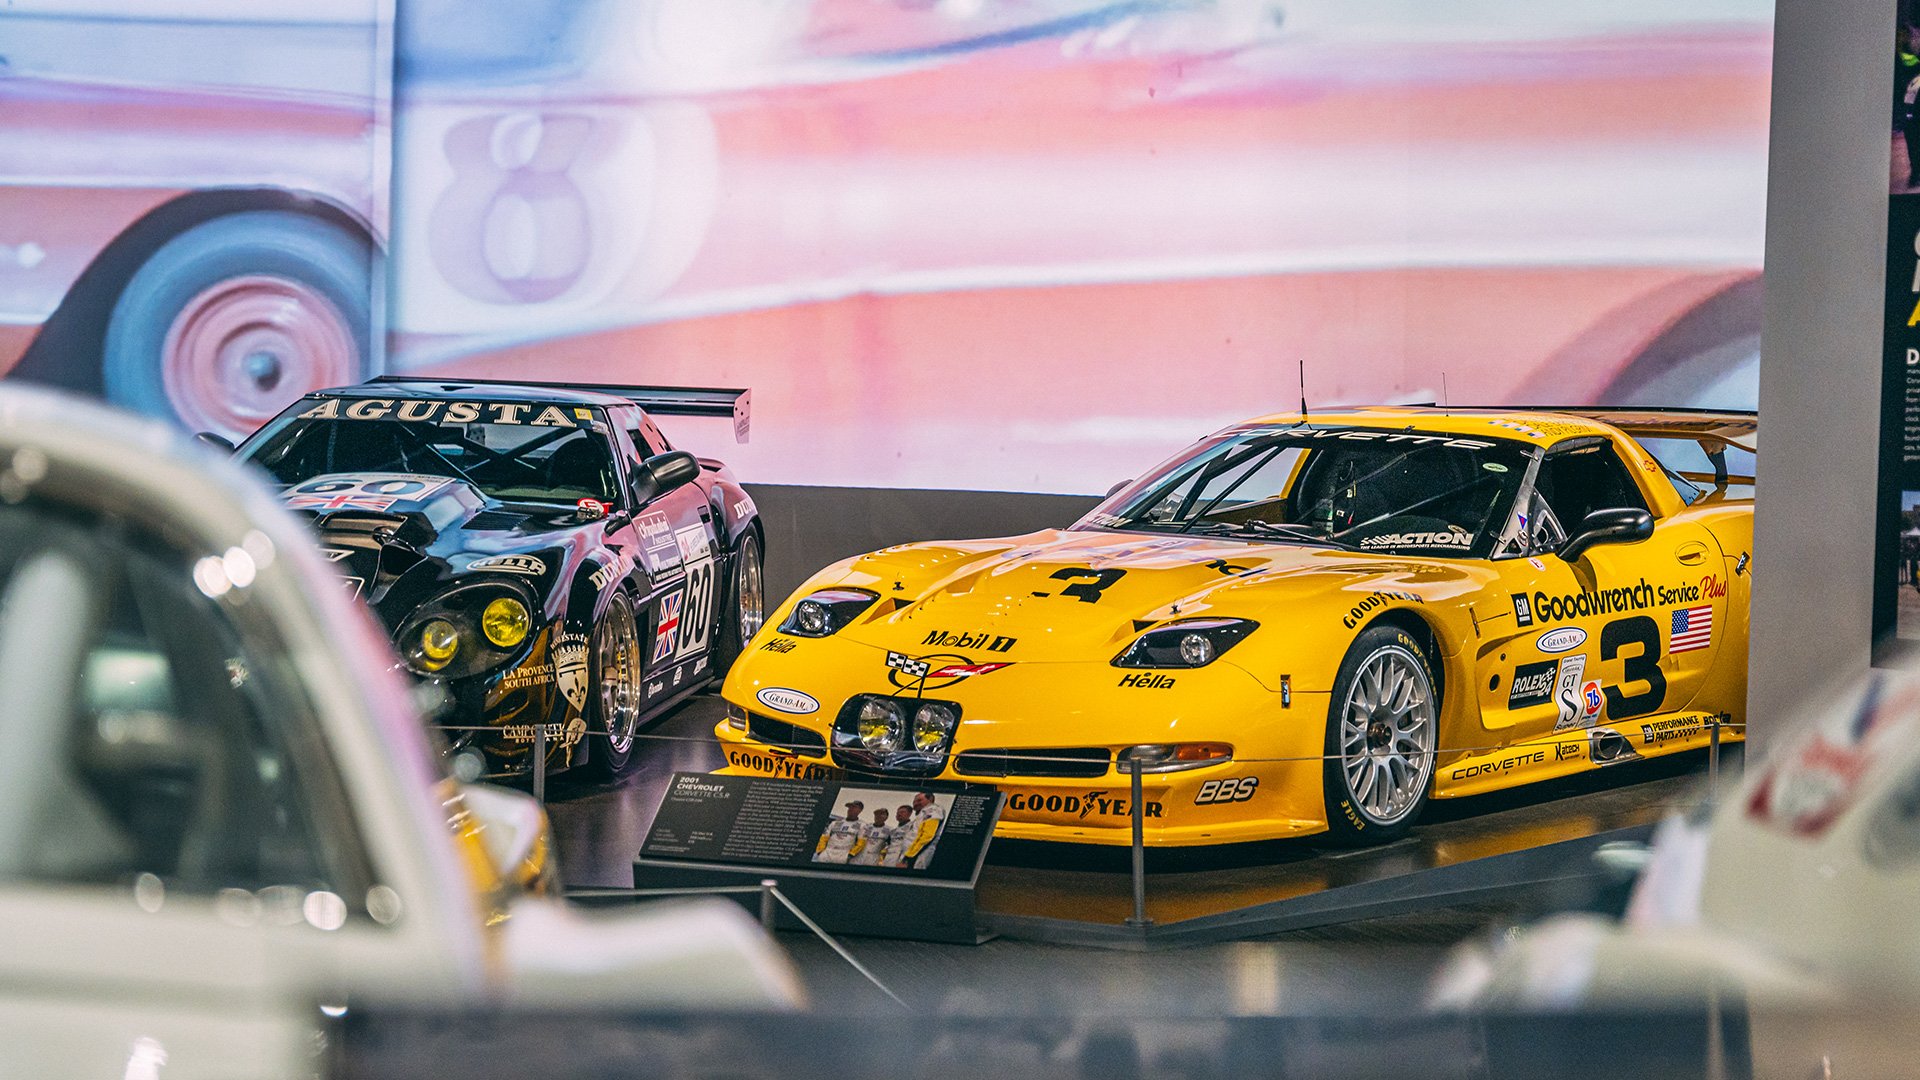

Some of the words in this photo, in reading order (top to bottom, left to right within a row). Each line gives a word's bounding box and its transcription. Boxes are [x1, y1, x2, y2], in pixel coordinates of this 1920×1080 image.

[297, 397, 577, 428] AGUSTA
[1384, 531, 1475, 546] ACTION
[682, 563, 714, 650] 60
[1534, 577, 1654, 624] Goodwrench
[1658, 581, 1700, 606] Service
[1700, 573, 1727, 601] Plus
[921, 630, 992, 649] Mobil
[503, 669, 516, 680] LA
[517, 662, 555, 677] PROVENCE
[1600, 616, 1667, 721] 3
[504, 679, 532, 690] SOUTH
[533, 675, 555, 687] AFRICA
[1118, 672, 1176, 690] Hella
[1512, 673, 1545, 694] ROLEX
[1538, 680, 1554, 697] 24
[1563, 673, 1578, 689] GT
[1561, 688, 1577, 722] S
[1652, 715, 1700, 732] PERFORMANCE
[1655, 730, 1674, 742] PARTS
[1452, 751, 1544, 780] CORVETTE
[677, 783, 724, 792] CHEVROLET
[680, 776, 700, 784] 2001
[674, 790, 711, 799] CORVETTE
[1194, 777, 1259, 806] BBS
[1340, 800, 1367, 831] EAGLE
